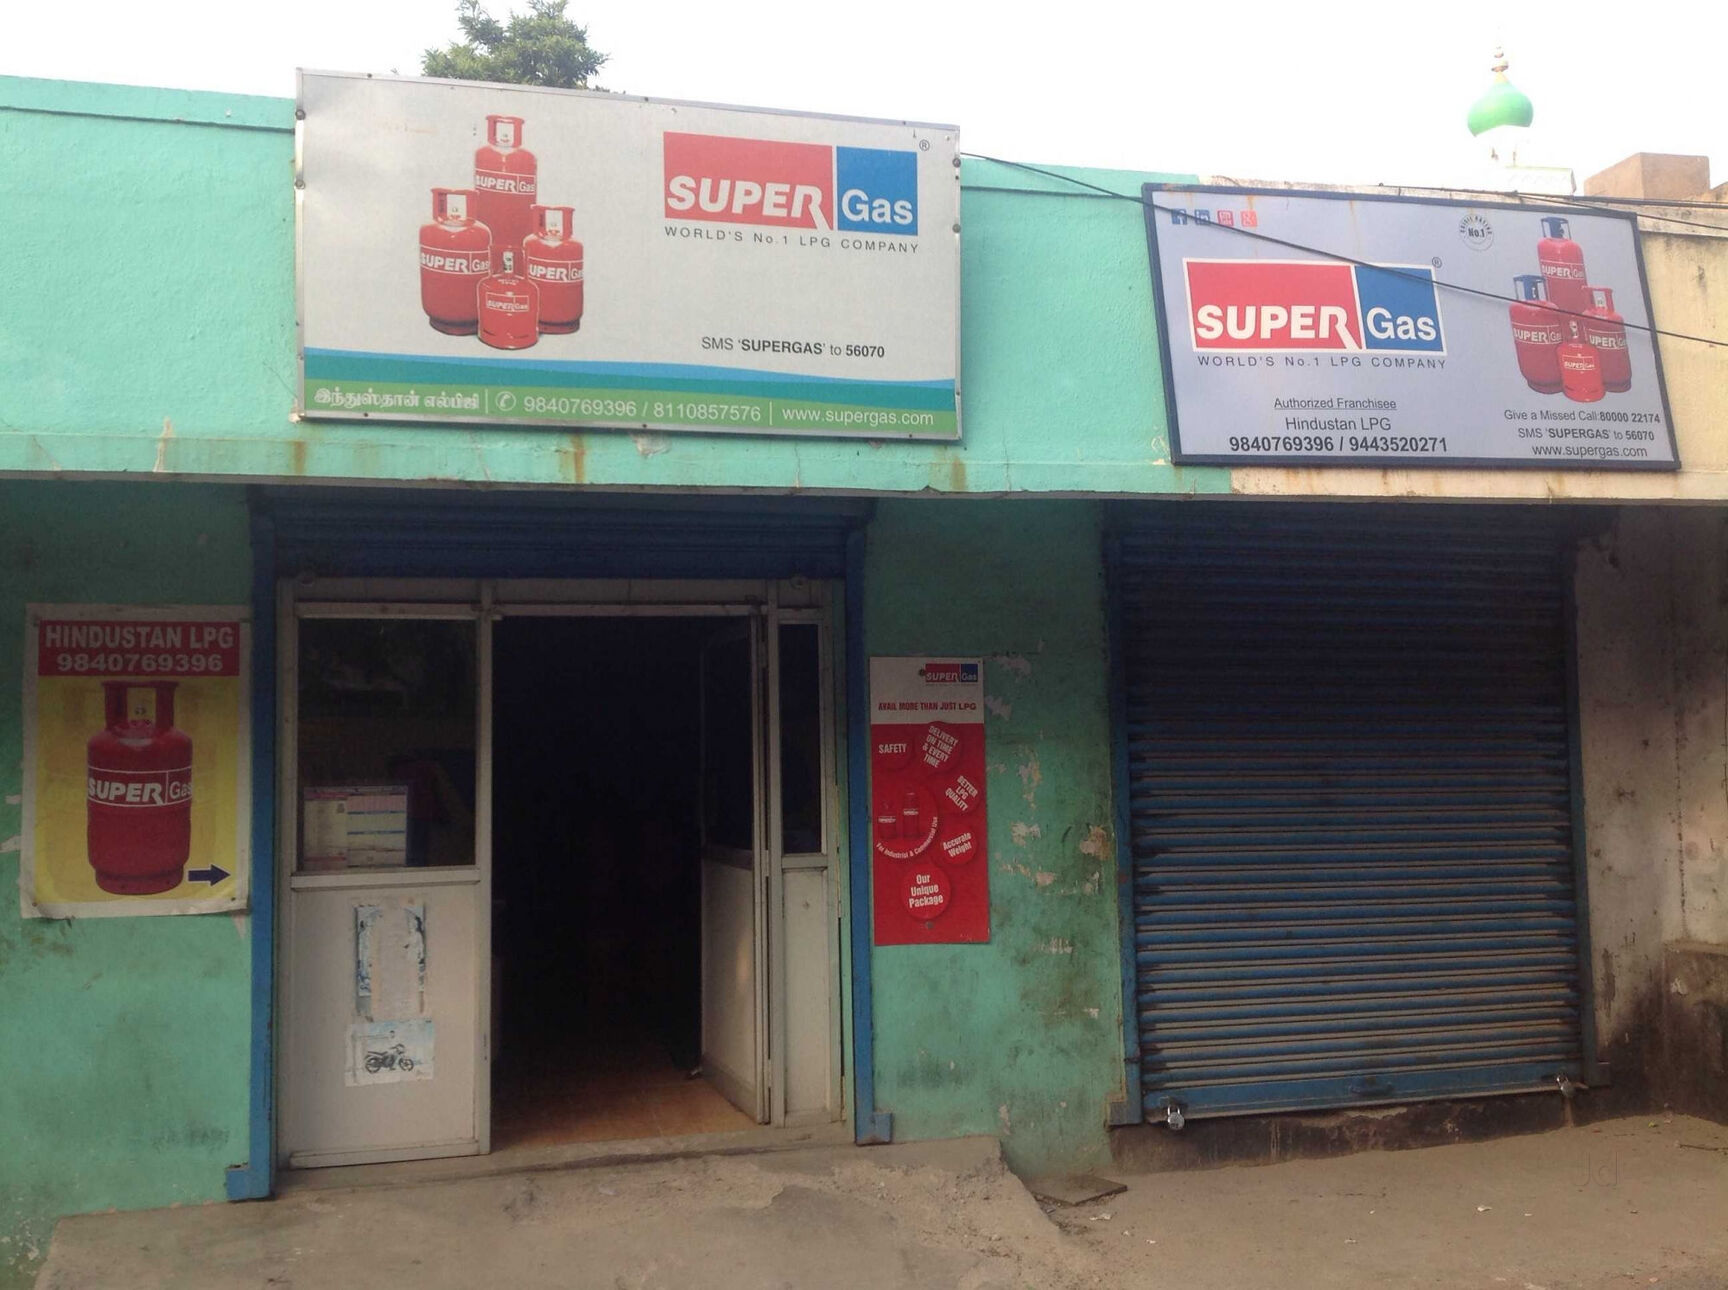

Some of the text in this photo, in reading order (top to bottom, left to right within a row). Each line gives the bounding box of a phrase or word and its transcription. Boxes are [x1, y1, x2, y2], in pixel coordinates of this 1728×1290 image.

[667, 175, 914, 231] SUPER Gas
[664, 226, 744, 242] WORLD'S
[800, 233, 830, 248] LPG
[841, 239, 919, 254] COMPANY
[529, 264, 568, 282] UPER
[1196, 304, 1437, 350] SUPER Gas
[702, 336, 734, 351] SMS
[830, 344, 842, 356] to
[846, 345, 885, 358] 56070
[1590, 335, 1618, 350] UPER
[1198, 356, 1447, 369] WORLD'S No.1 LPG COMPANY
[1274, 398, 1397, 409] Authorized Franchisee
[523, 397, 637, 417] 9840769396
[653, 402, 761, 422] 8110857576
[782, 406, 934, 426] www.supergas.com
[1504, 410, 1528, 420] Give
[1530, 412, 1538, 420] a
[1540, 410, 1576, 421] Missed
[1631, 413, 1660, 423] 22174
[1286, 417, 1392, 431] Hindustan LPG
[1518, 428, 1544, 438] SMS
[1614, 430, 1623, 440] to
[1626, 430, 1655, 441] 56070
[1229, 436, 1334, 452] 9840769396
[1349, 436, 1448, 452] 9443520271
[1532, 446, 1648, 459] www.supergas.com
[46, 624, 234, 648] HINDUSTAN LPG
[56, 654, 223, 672] 9840769396
[926, 672, 977, 682] SUPER Gas
[878, 702, 977, 711] AVAIL MORE THAN JUST LPG
[928, 726, 959, 747] DELIVERY
[878, 743, 907, 754] SAFETY
[922, 742, 949, 762] & EVERY
[937, 740, 953, 755] TIME
[923, 753, 940, 768] TIME
[945, 788, 968, 811] QUALITY
[956, 786, 968, 800] LPG
[943, 832, 972, 851] Accurate
[948, 841, 972, 858] Weight
[916, 874, 930, 885] Our
[910, 883, 939, 896] Unique
[908, 894, 944, 908] Package
